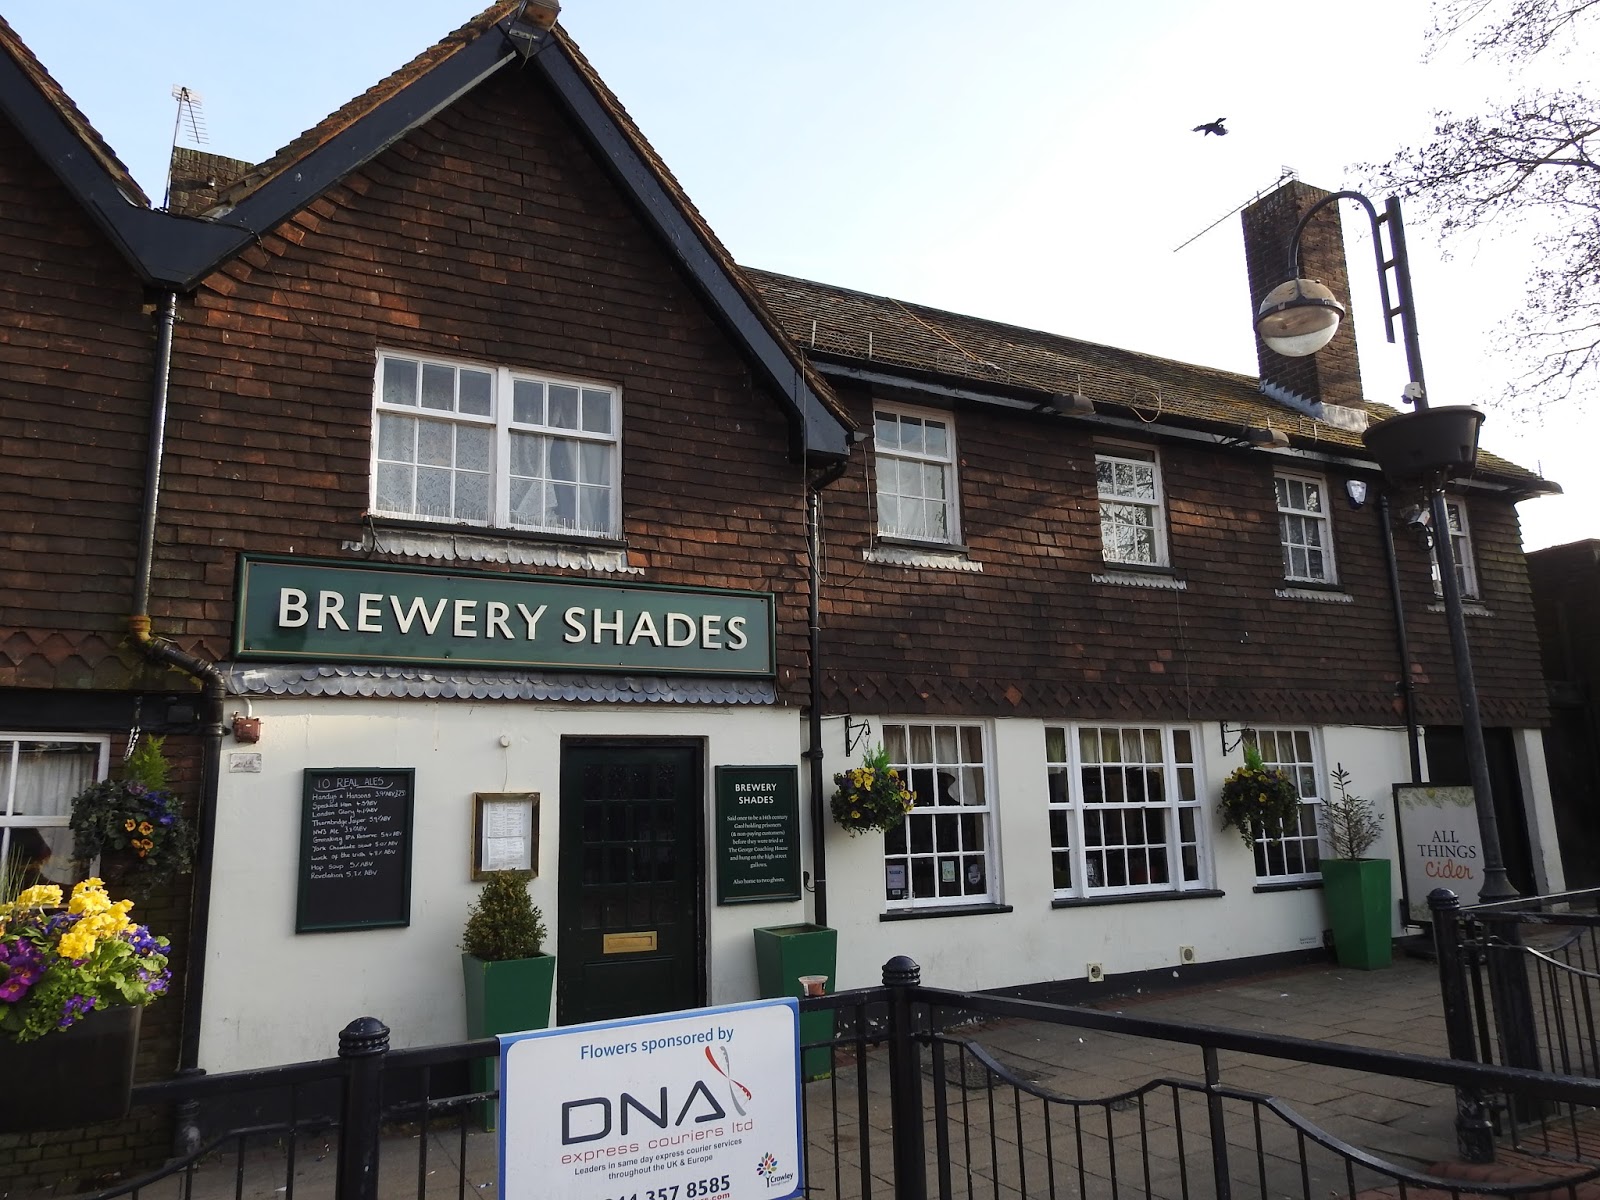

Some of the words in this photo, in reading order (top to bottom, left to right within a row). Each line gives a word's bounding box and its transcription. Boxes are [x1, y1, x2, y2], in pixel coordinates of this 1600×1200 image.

[277, 587, 547, 640] BREWERY
[562, 607, 748, 651] SHADES
[318, 779, 330, 789] 10
[336, 777, 359, 788] REAL
[364, 777, 384, 786] ALES
[735, 783, 777, 792] BREWERY
[738, 795, 774, 805] SHADES
[312, 810, 335, 818] London
[338, 808, 355, 818] Glory
[1432, 830, 1459, 843] ALL
[312, 845, 326, 853] York
[1417, 844, 1477, 859] THINGS
[311, 864, 324, 872] Hop
[310, 871, 344, 879] Revelation
[580, 1042, 637, 1060] Flowers
[641, 1029, 713, 1053] sponsored
[717, 1027, 734, 1043] by
[561, 1080, 726, 1146] DNA
[561, 1143, 639, 1164] express
[648, 1126, 724, 1149] couriers
[732, 1118, 753, 1133] ltd
[574, 1164, 606, 1176] Leaders
[608, 1161, 616, 1169] in
[618, 1158, 638, 1168] same
[640, 1155, 653, 1164] day
[655, 1150, 685, 1161] express
[686, 1144, 712, 1155] courier
[713, 1138, 743, 1150] services
[608, 1165, 651, 1180] throughout
[652, 1163, 665, 1171] the
[666, 1160, 678, 1169] UK
[687, 1154, 713, 1165] Europe
[770, 1172, 794, 1184] Crawley
[645, 1185, 680, 1200] 357
[686, 1174, 731, 1199] 8585
